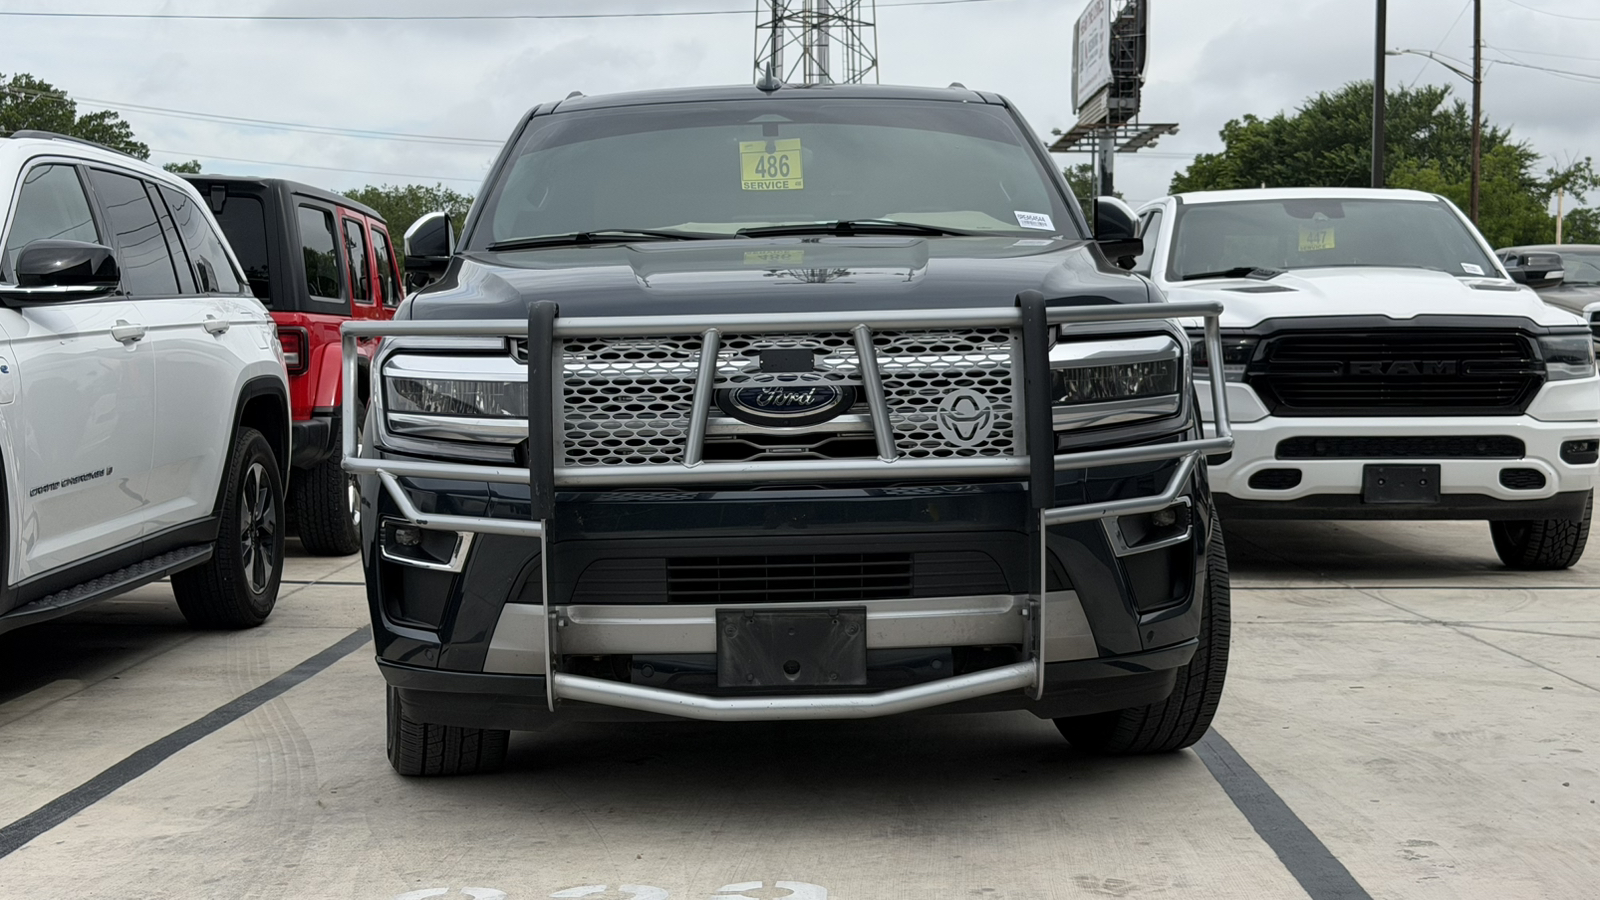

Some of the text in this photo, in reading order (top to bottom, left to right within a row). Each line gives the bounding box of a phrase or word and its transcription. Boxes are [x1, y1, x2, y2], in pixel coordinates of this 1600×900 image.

[755, 154, 790, 178] 486
[743, 181, 789, 190] SERVICE
[1307, 231, 1327, 244] 447
[1350, 360, 1457, 375] RAM
[756, 387, 816, 407] Ford
